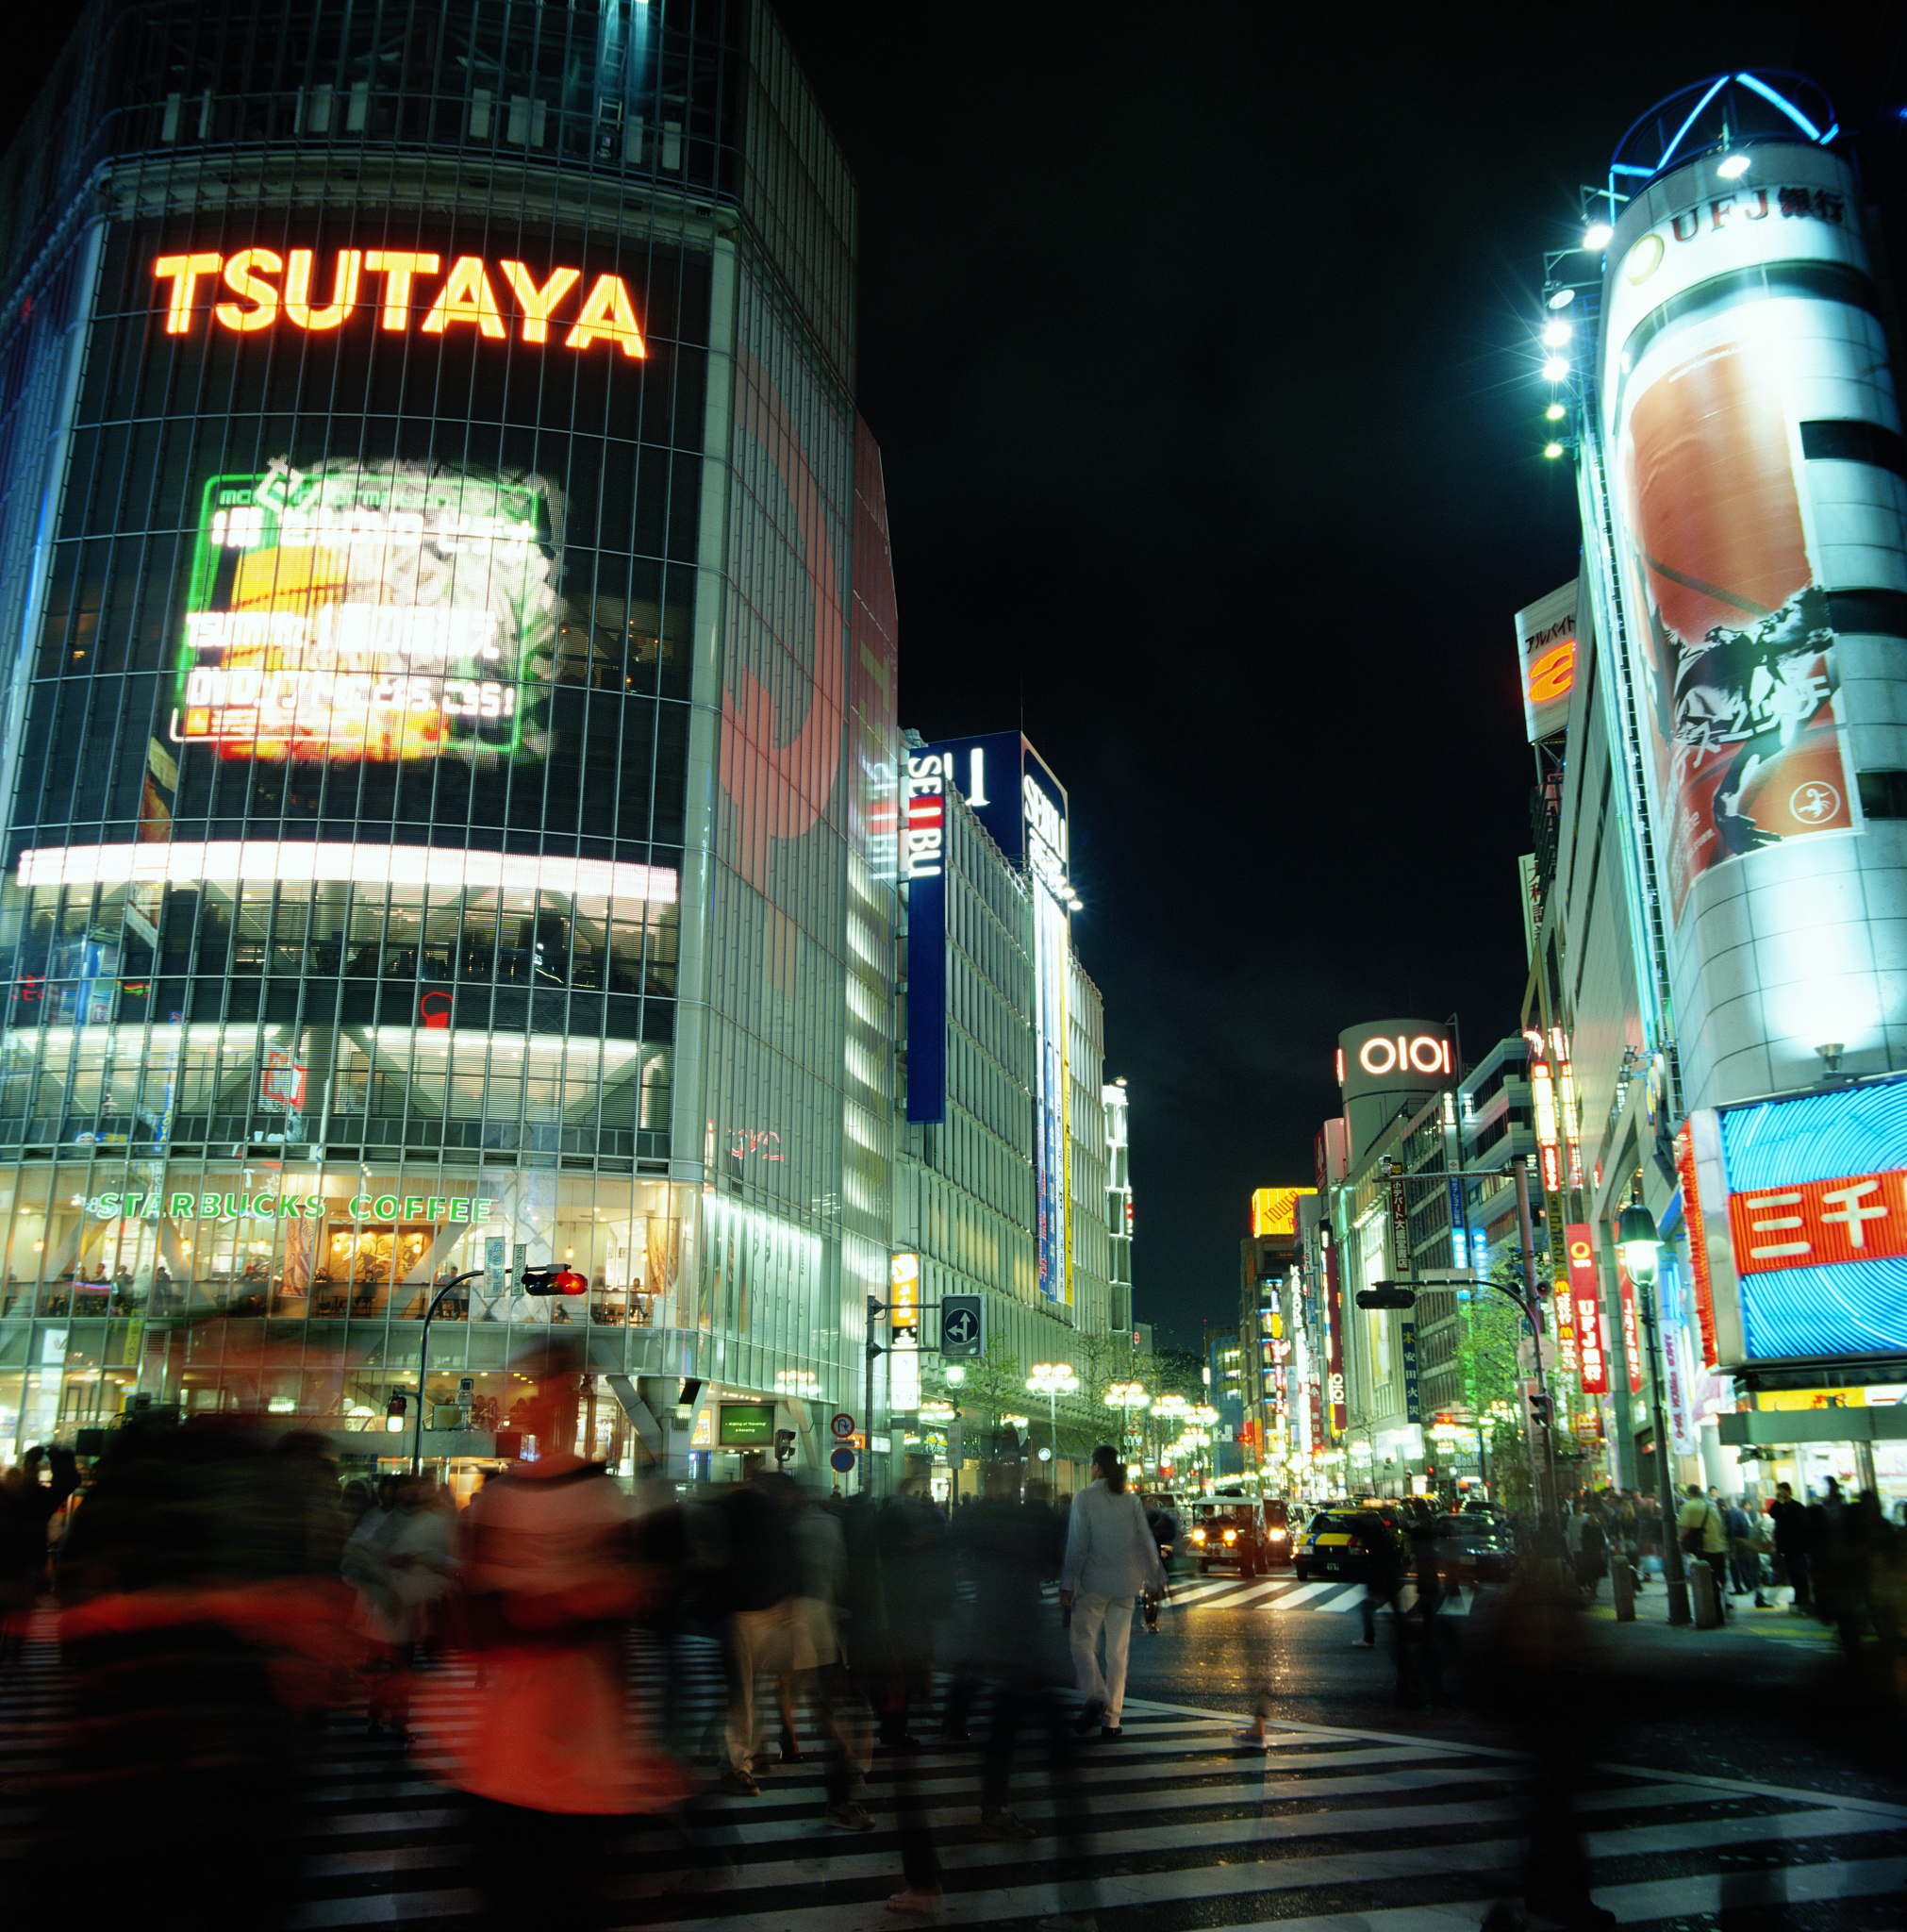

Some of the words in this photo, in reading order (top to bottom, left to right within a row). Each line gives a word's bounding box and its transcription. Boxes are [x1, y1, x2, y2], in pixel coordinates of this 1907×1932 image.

[155, 248, 648, 358] TSUTAYA
[1525, 614, 1575, 654] アルバイト
[907, 755, 942, 878] SEIBU
[95, 1191, 326, 1220] STARBUCKS
[349, 1192, 492, 1224] COFFEE
[1746, 1175, 1907, 1259] 三千
[492, 1241, 503, 1293] 渋谷駅前
[1289, 1264, 1303, 1328] KARAOKE
[1404, 1351, 1419, 1415] 安田火災
